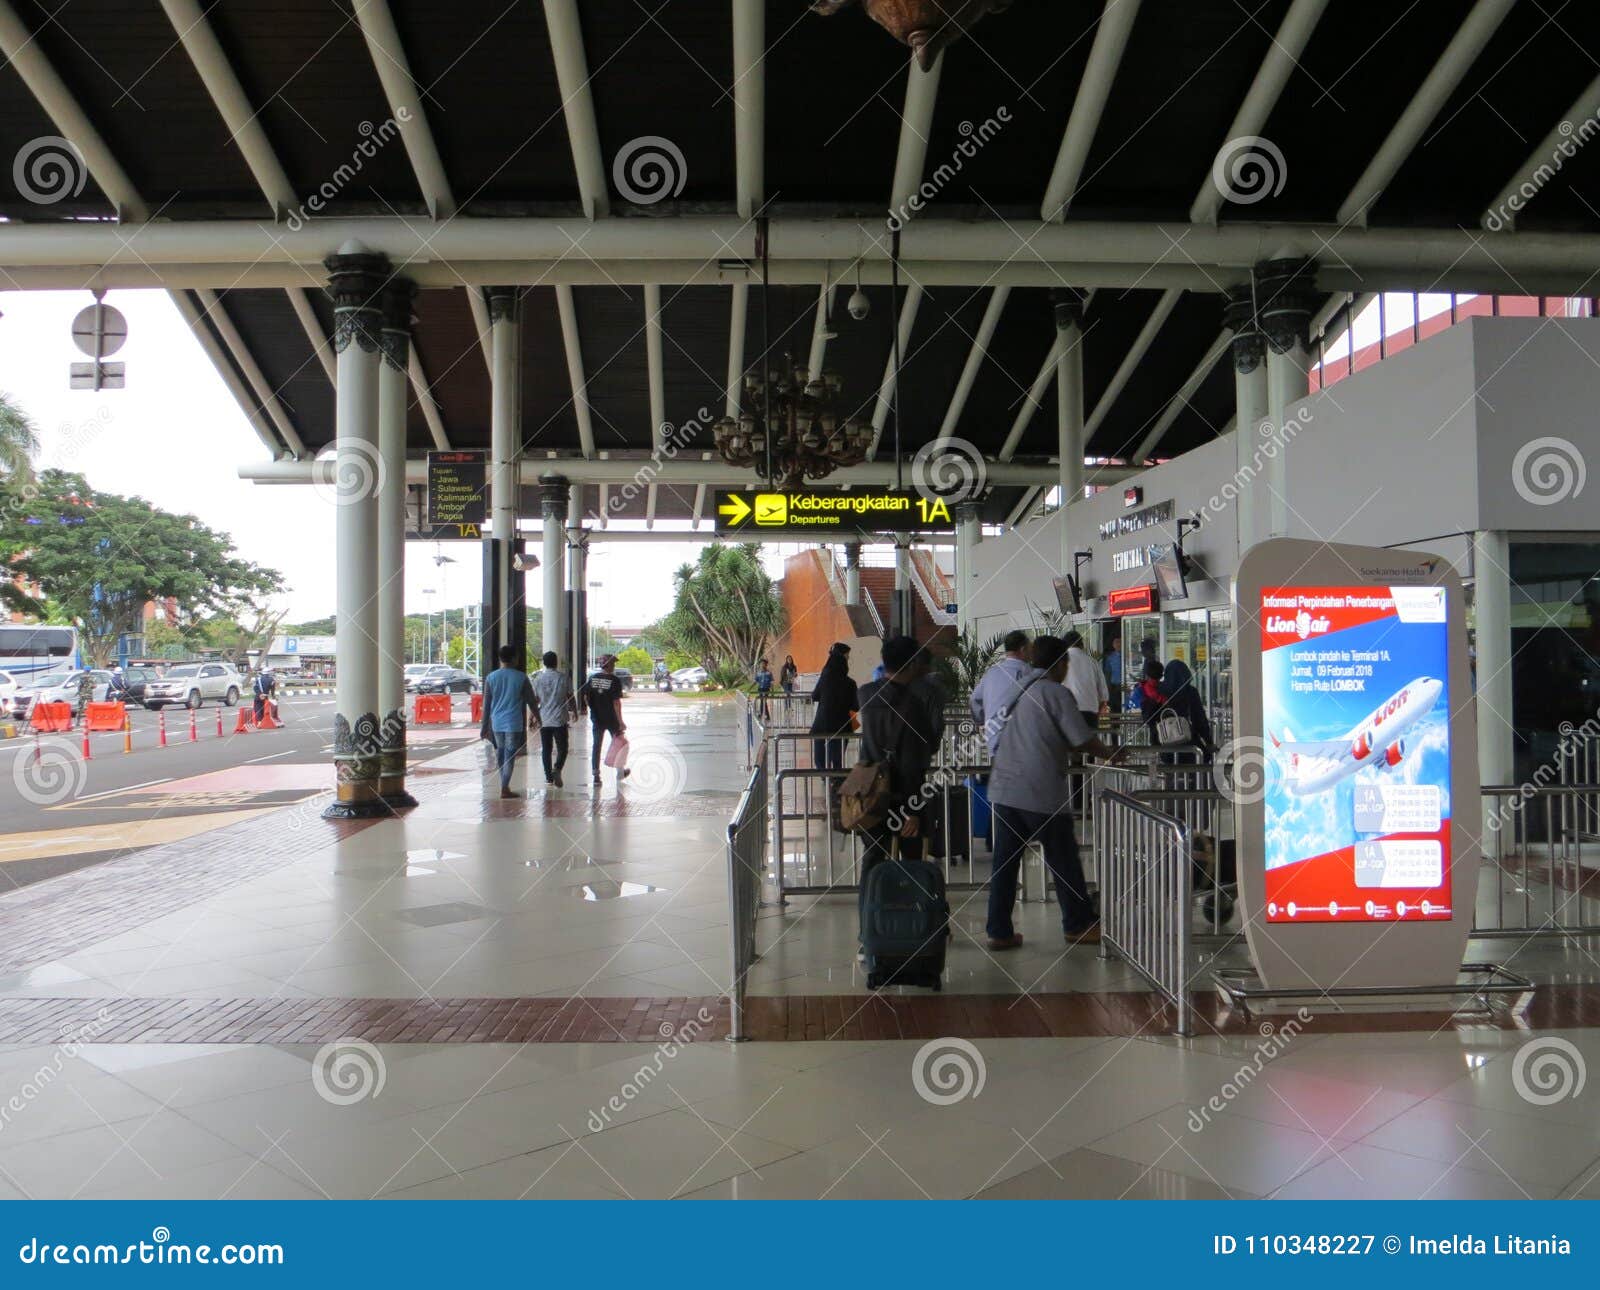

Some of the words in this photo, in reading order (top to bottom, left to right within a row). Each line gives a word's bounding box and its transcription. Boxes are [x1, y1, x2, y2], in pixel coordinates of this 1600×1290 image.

[438, 484, 473, 492] Sulawesi
[437, 503, 465, 511] Ambon
[789, 494, 909, 513] Keberangkatan
[916, 497, 951, 523] 1A
[437, 512, 463, 520] Papua
[790, 514, 840, 524] Departures
[457, 523, 479, 537] 1A
[1263, 595, 1298, 608] Informasi
[1299, 595, 1344, 610] Perpindahan
[1266, 614, 1297, 633] Lion
[1310, 615, 1330, 633] air
[1290, 650, 1317, 662] Lombok
[1318, 650, 1340, 664] pindah
[1351, 650, 1379, 662] Terminal
[1317, 665, 1326, 676] 09
[1327, 665, 1354, 676] Februari
[1355, 665, 1373, 676] 2018
[1331, 680, 1365, 692] LOMBOK
